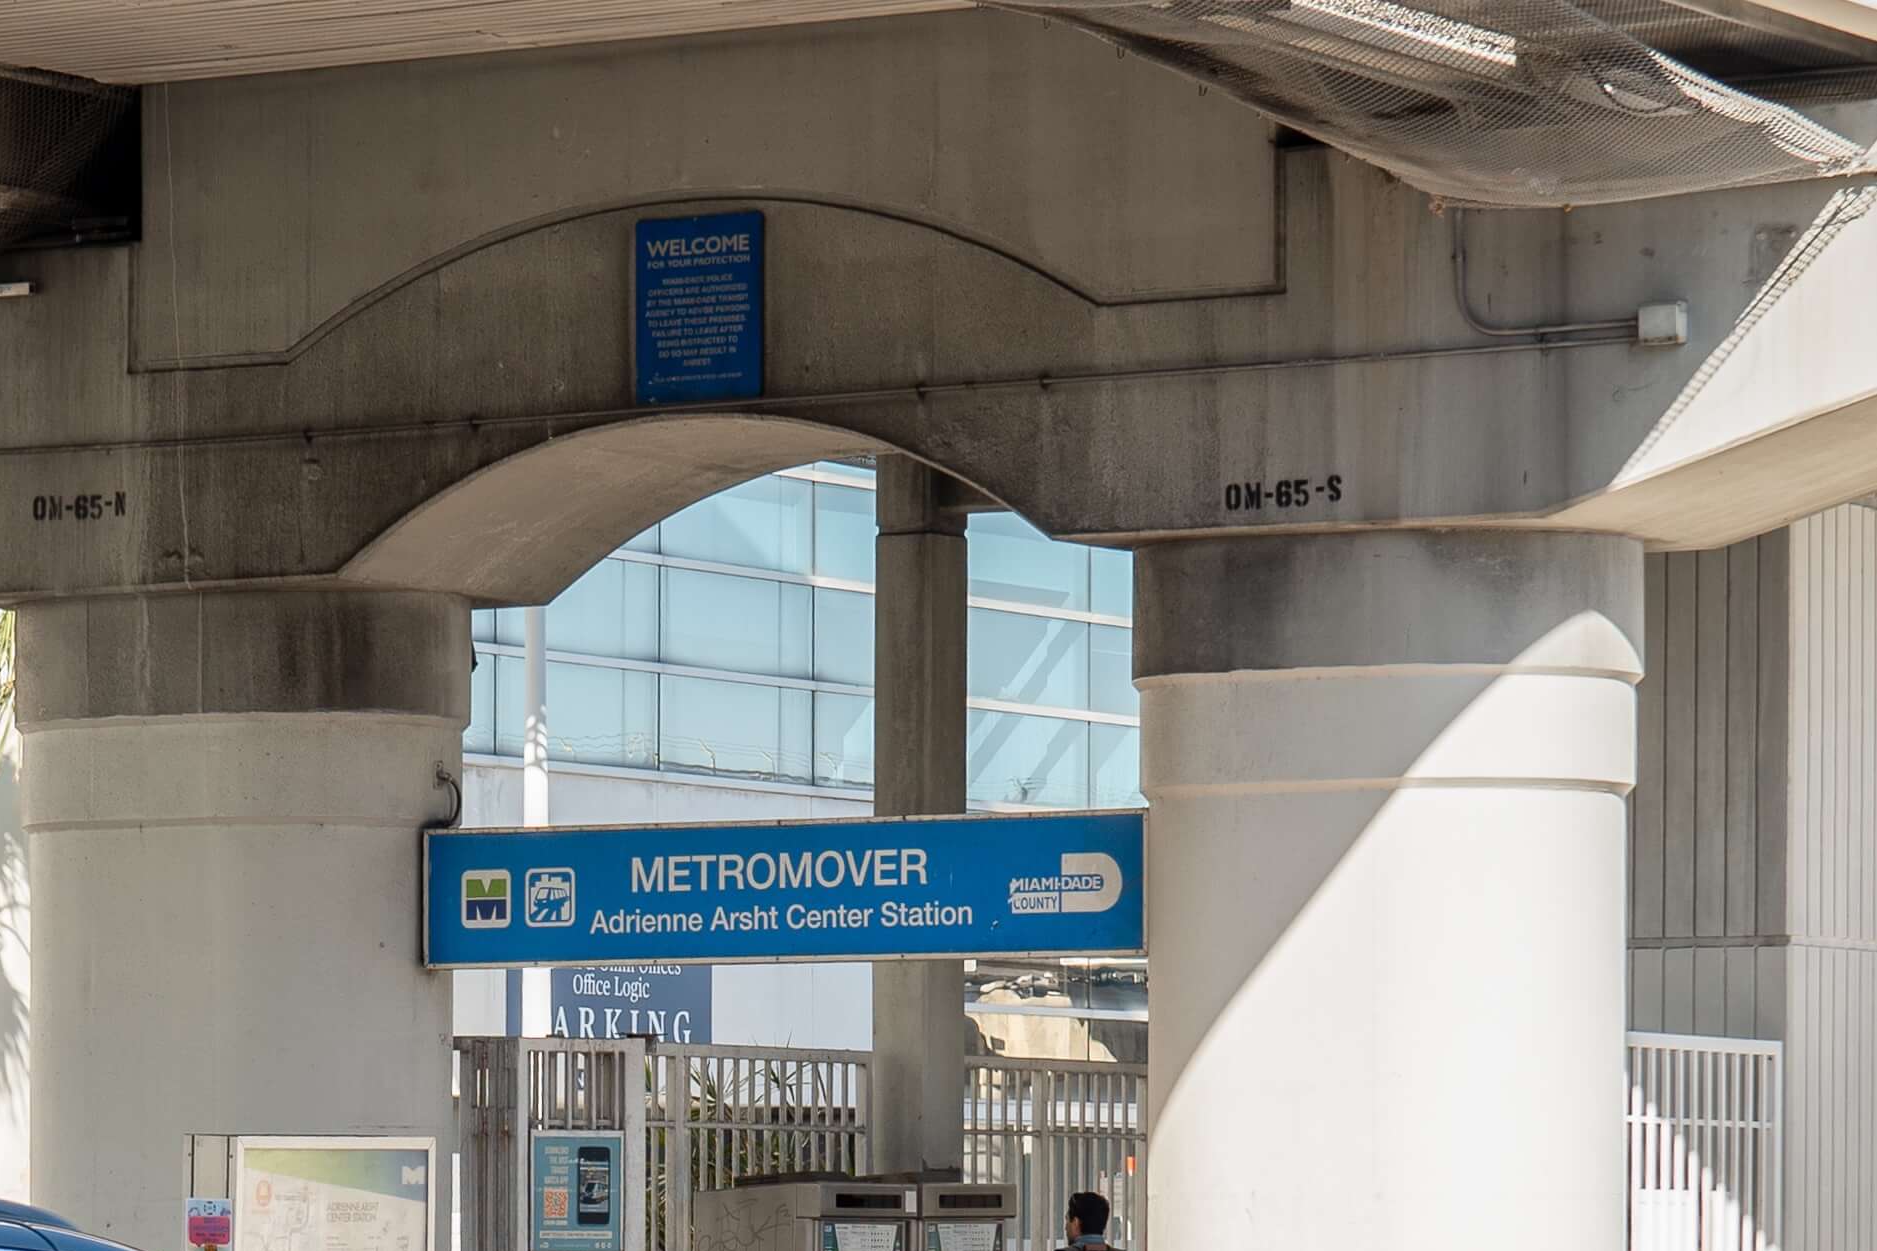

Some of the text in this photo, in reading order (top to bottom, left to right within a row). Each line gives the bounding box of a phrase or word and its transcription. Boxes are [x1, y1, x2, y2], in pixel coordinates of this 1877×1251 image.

[646, 233, 750, 258] WELCOME
[647, 260, 665, 270] FOR
[693, 253, 751, 266] PROTECTION
[630, 848, 928, 893] METROMOVER
[589, 897, 974, 935] Adrienne Arsht Center Station
[1013, 896, 1058, 910] COUNTY
[573, 974, 651, 1003] Office Logic
[554, 1006, 692, 1044] ARKING
